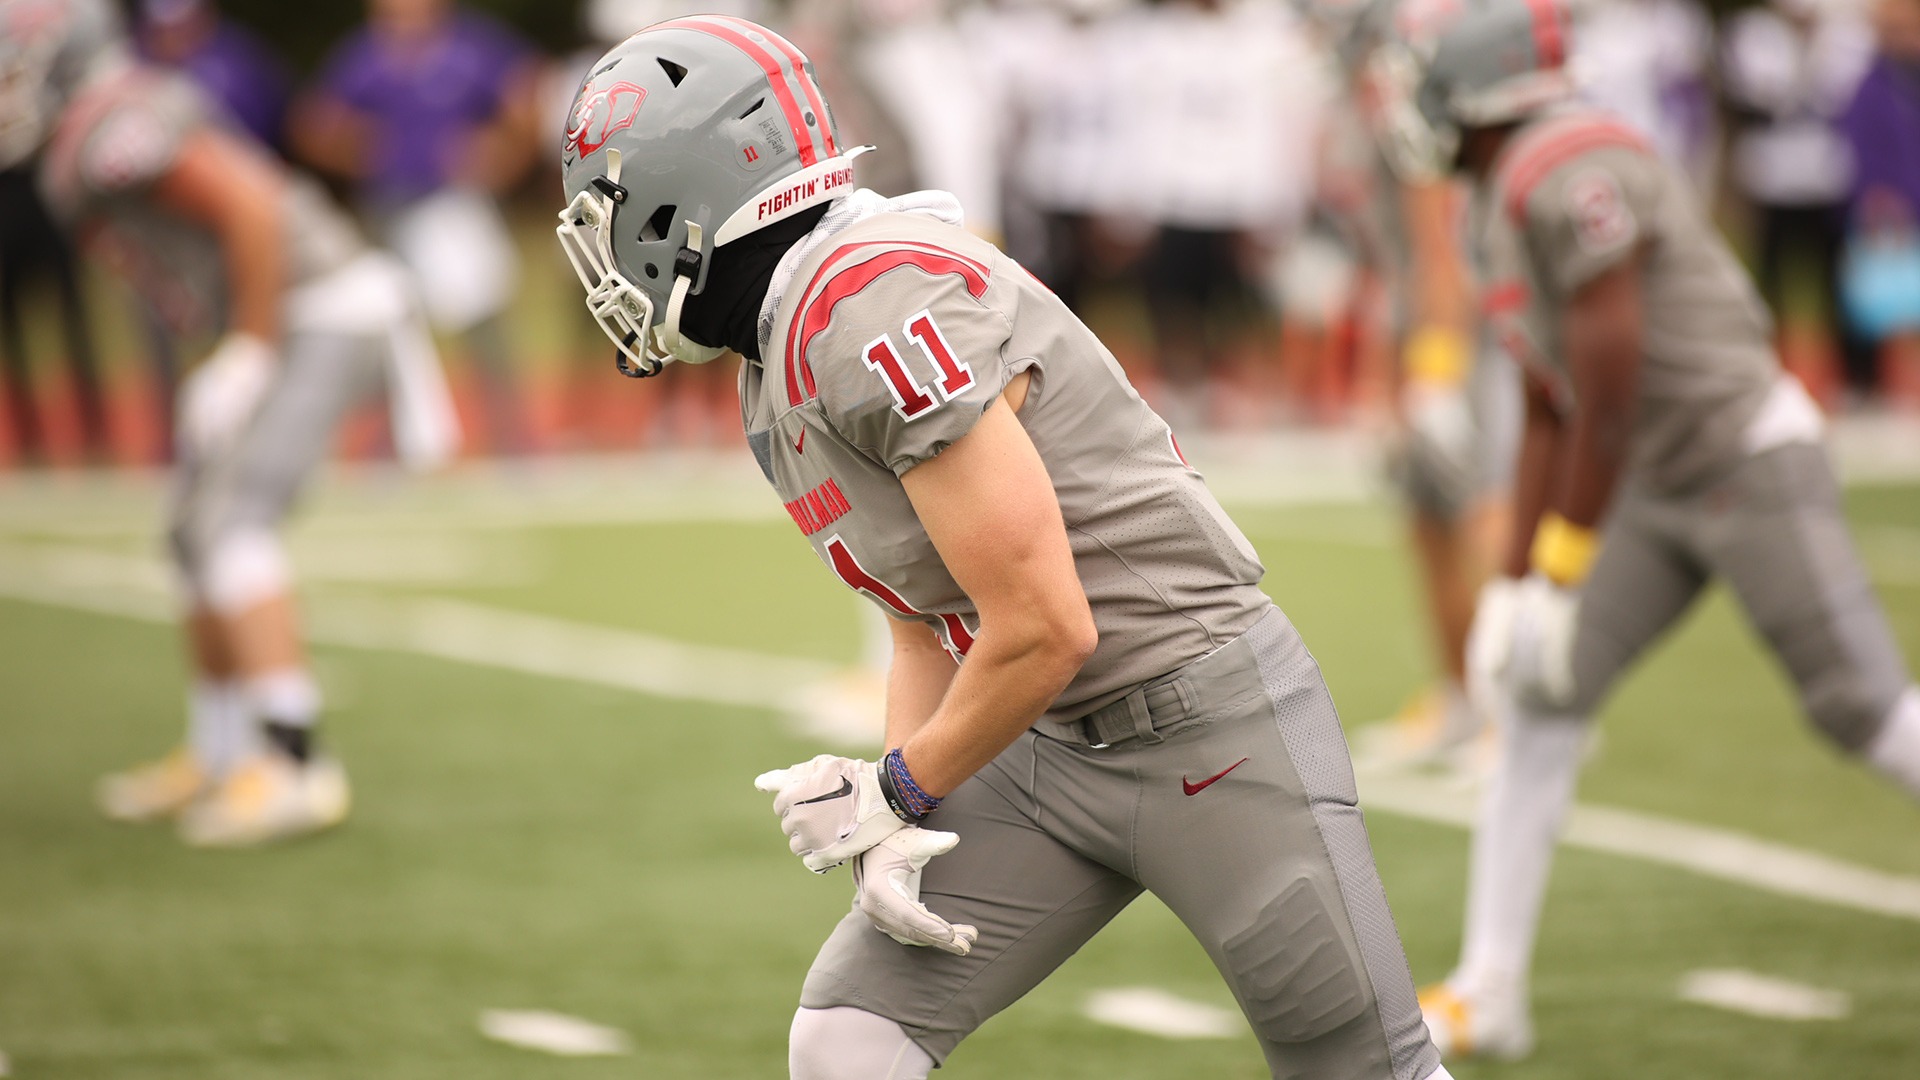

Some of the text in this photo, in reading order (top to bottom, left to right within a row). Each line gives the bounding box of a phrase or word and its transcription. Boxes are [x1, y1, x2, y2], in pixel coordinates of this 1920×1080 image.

[743, 145, 759, 163] 11
[758, 177, 820, 220] FIGHTIN'
[861, 308, 977, 423] 11
